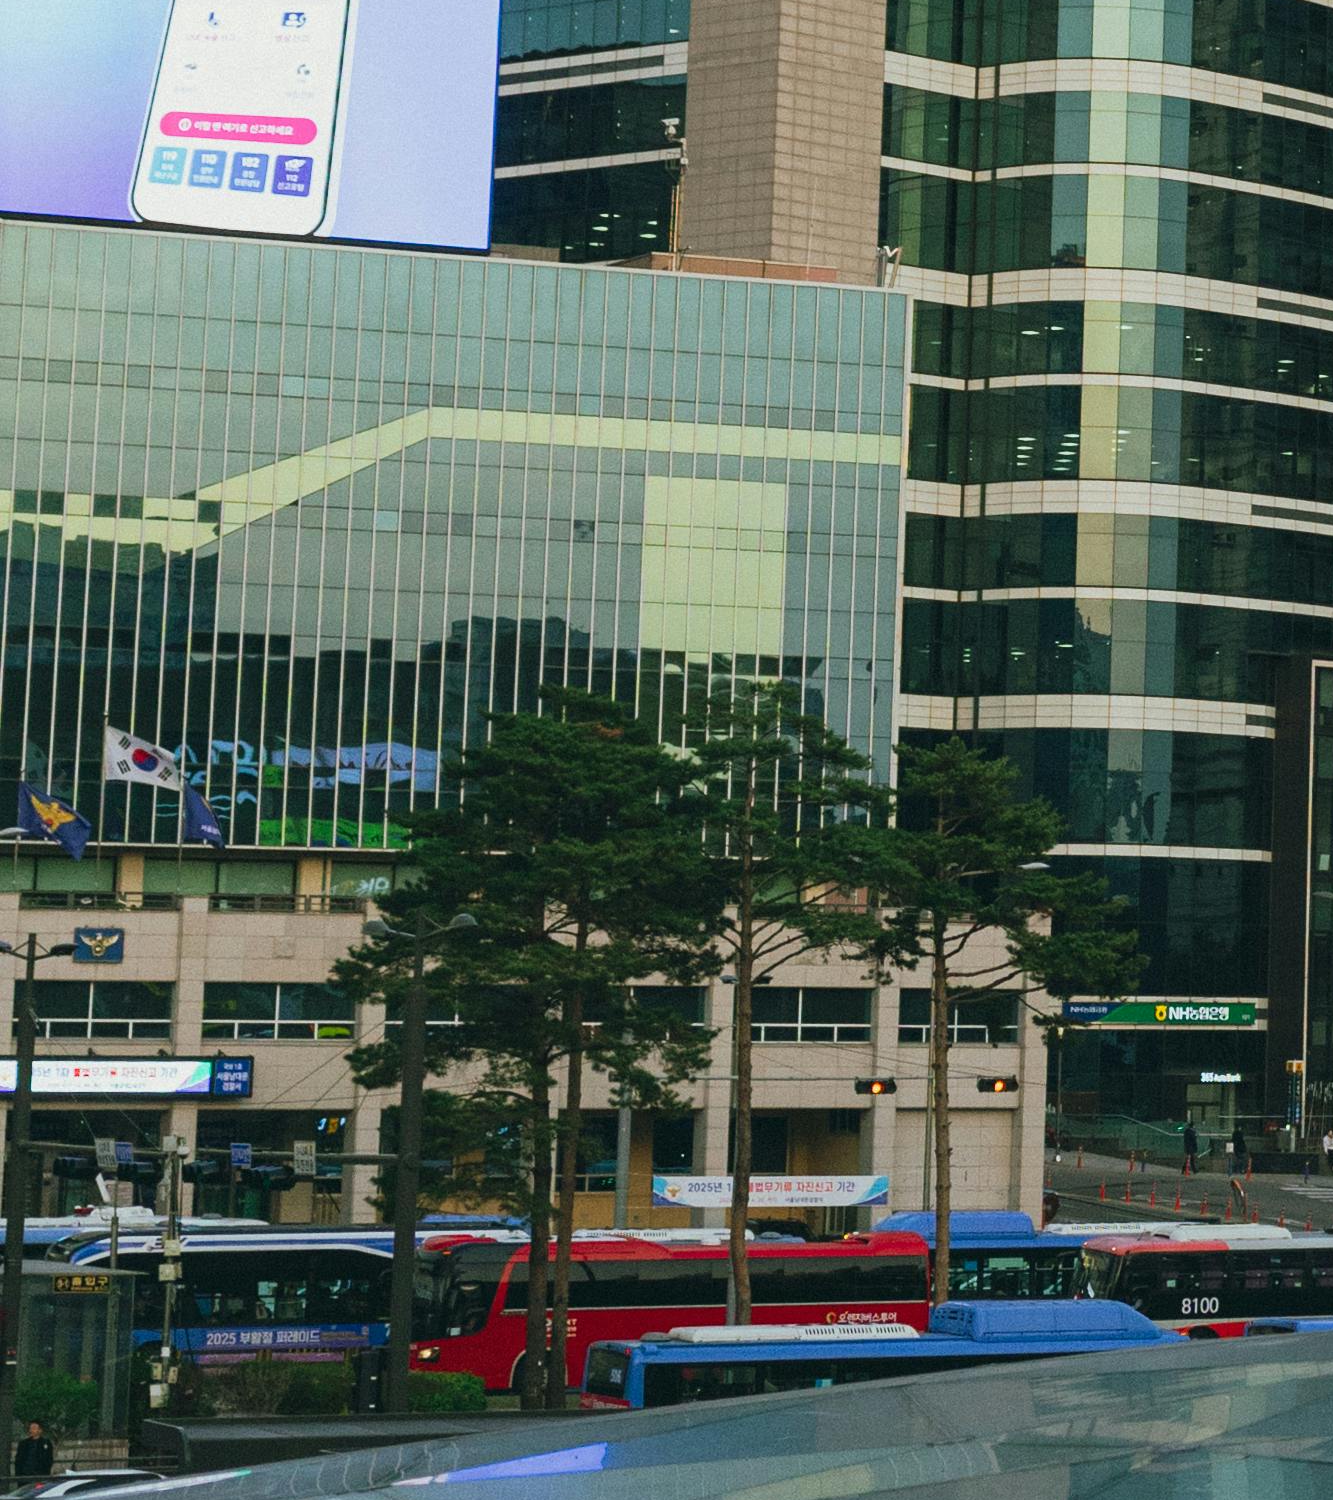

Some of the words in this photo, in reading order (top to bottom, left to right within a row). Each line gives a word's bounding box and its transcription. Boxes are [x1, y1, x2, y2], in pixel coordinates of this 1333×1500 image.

[1168, 1006, 1229, 1021] NH농협은행
[688, 1182, 722, 1193] 2025년
[796, 1181, 833, 1193] 자진신고
[836, 1181, 856, 1193] 기간
[1181, 1296, 1219, 1315] 8100
[207, 1332, 236, 1346] 2025
[276, 1329, 321, 1344] 퍼레이드
